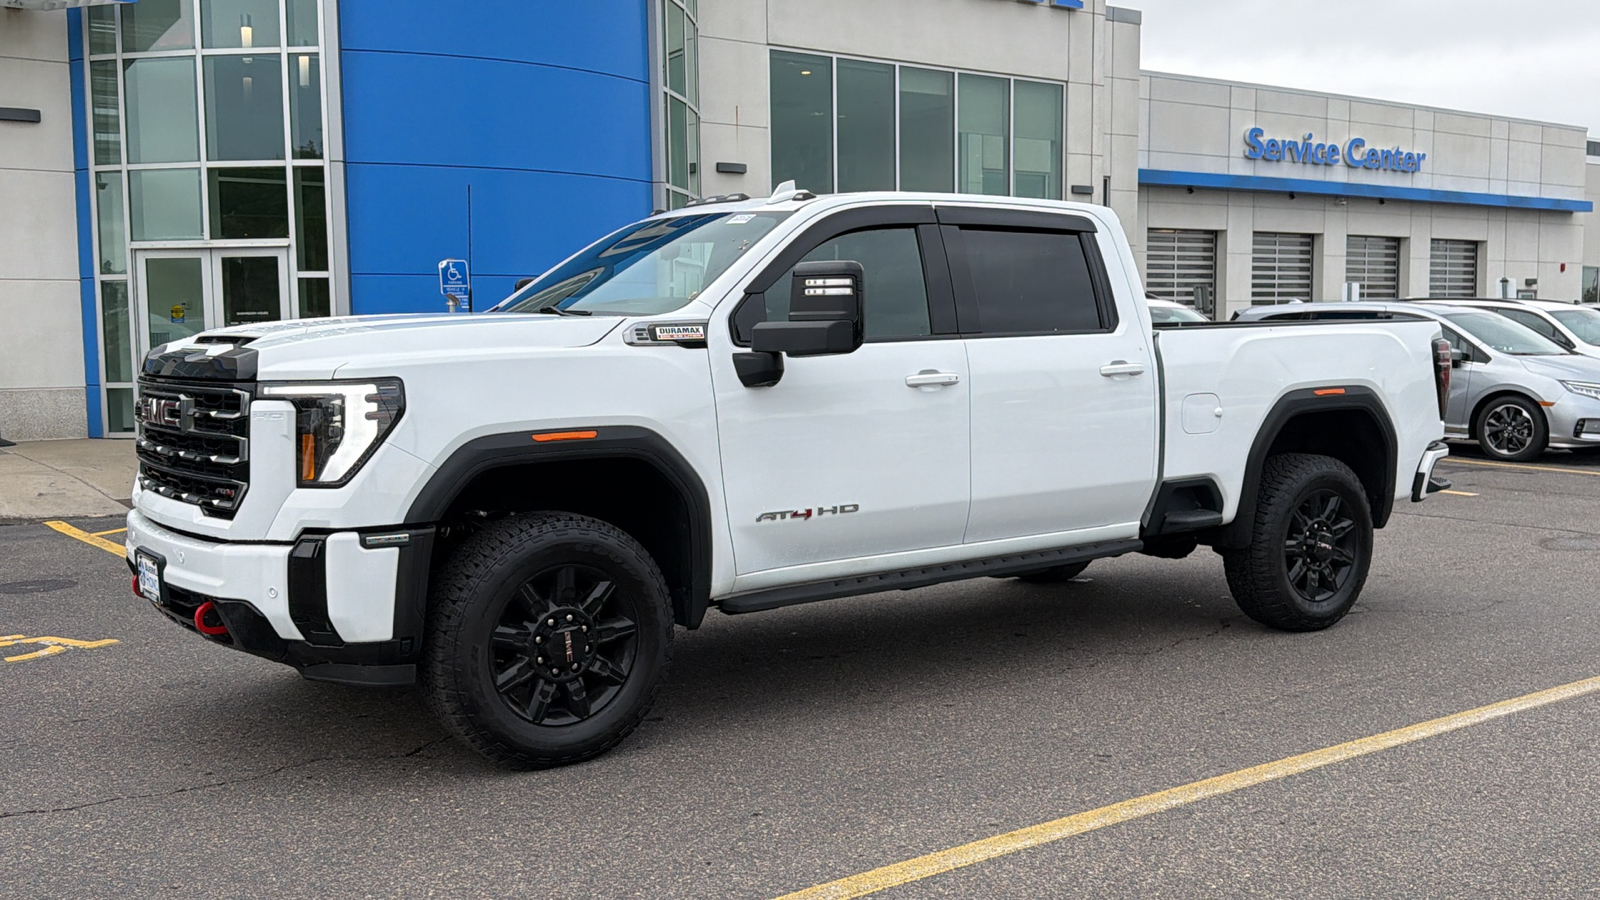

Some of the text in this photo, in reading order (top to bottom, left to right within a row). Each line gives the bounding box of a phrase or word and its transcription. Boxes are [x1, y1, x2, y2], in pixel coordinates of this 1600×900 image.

[1244, 127, 1427, 172] Service Center
[141, 396, 181, 428] GMC
[755, 503, 860, 523] AT4 HD
[564, 631, 574, 663] GMC
